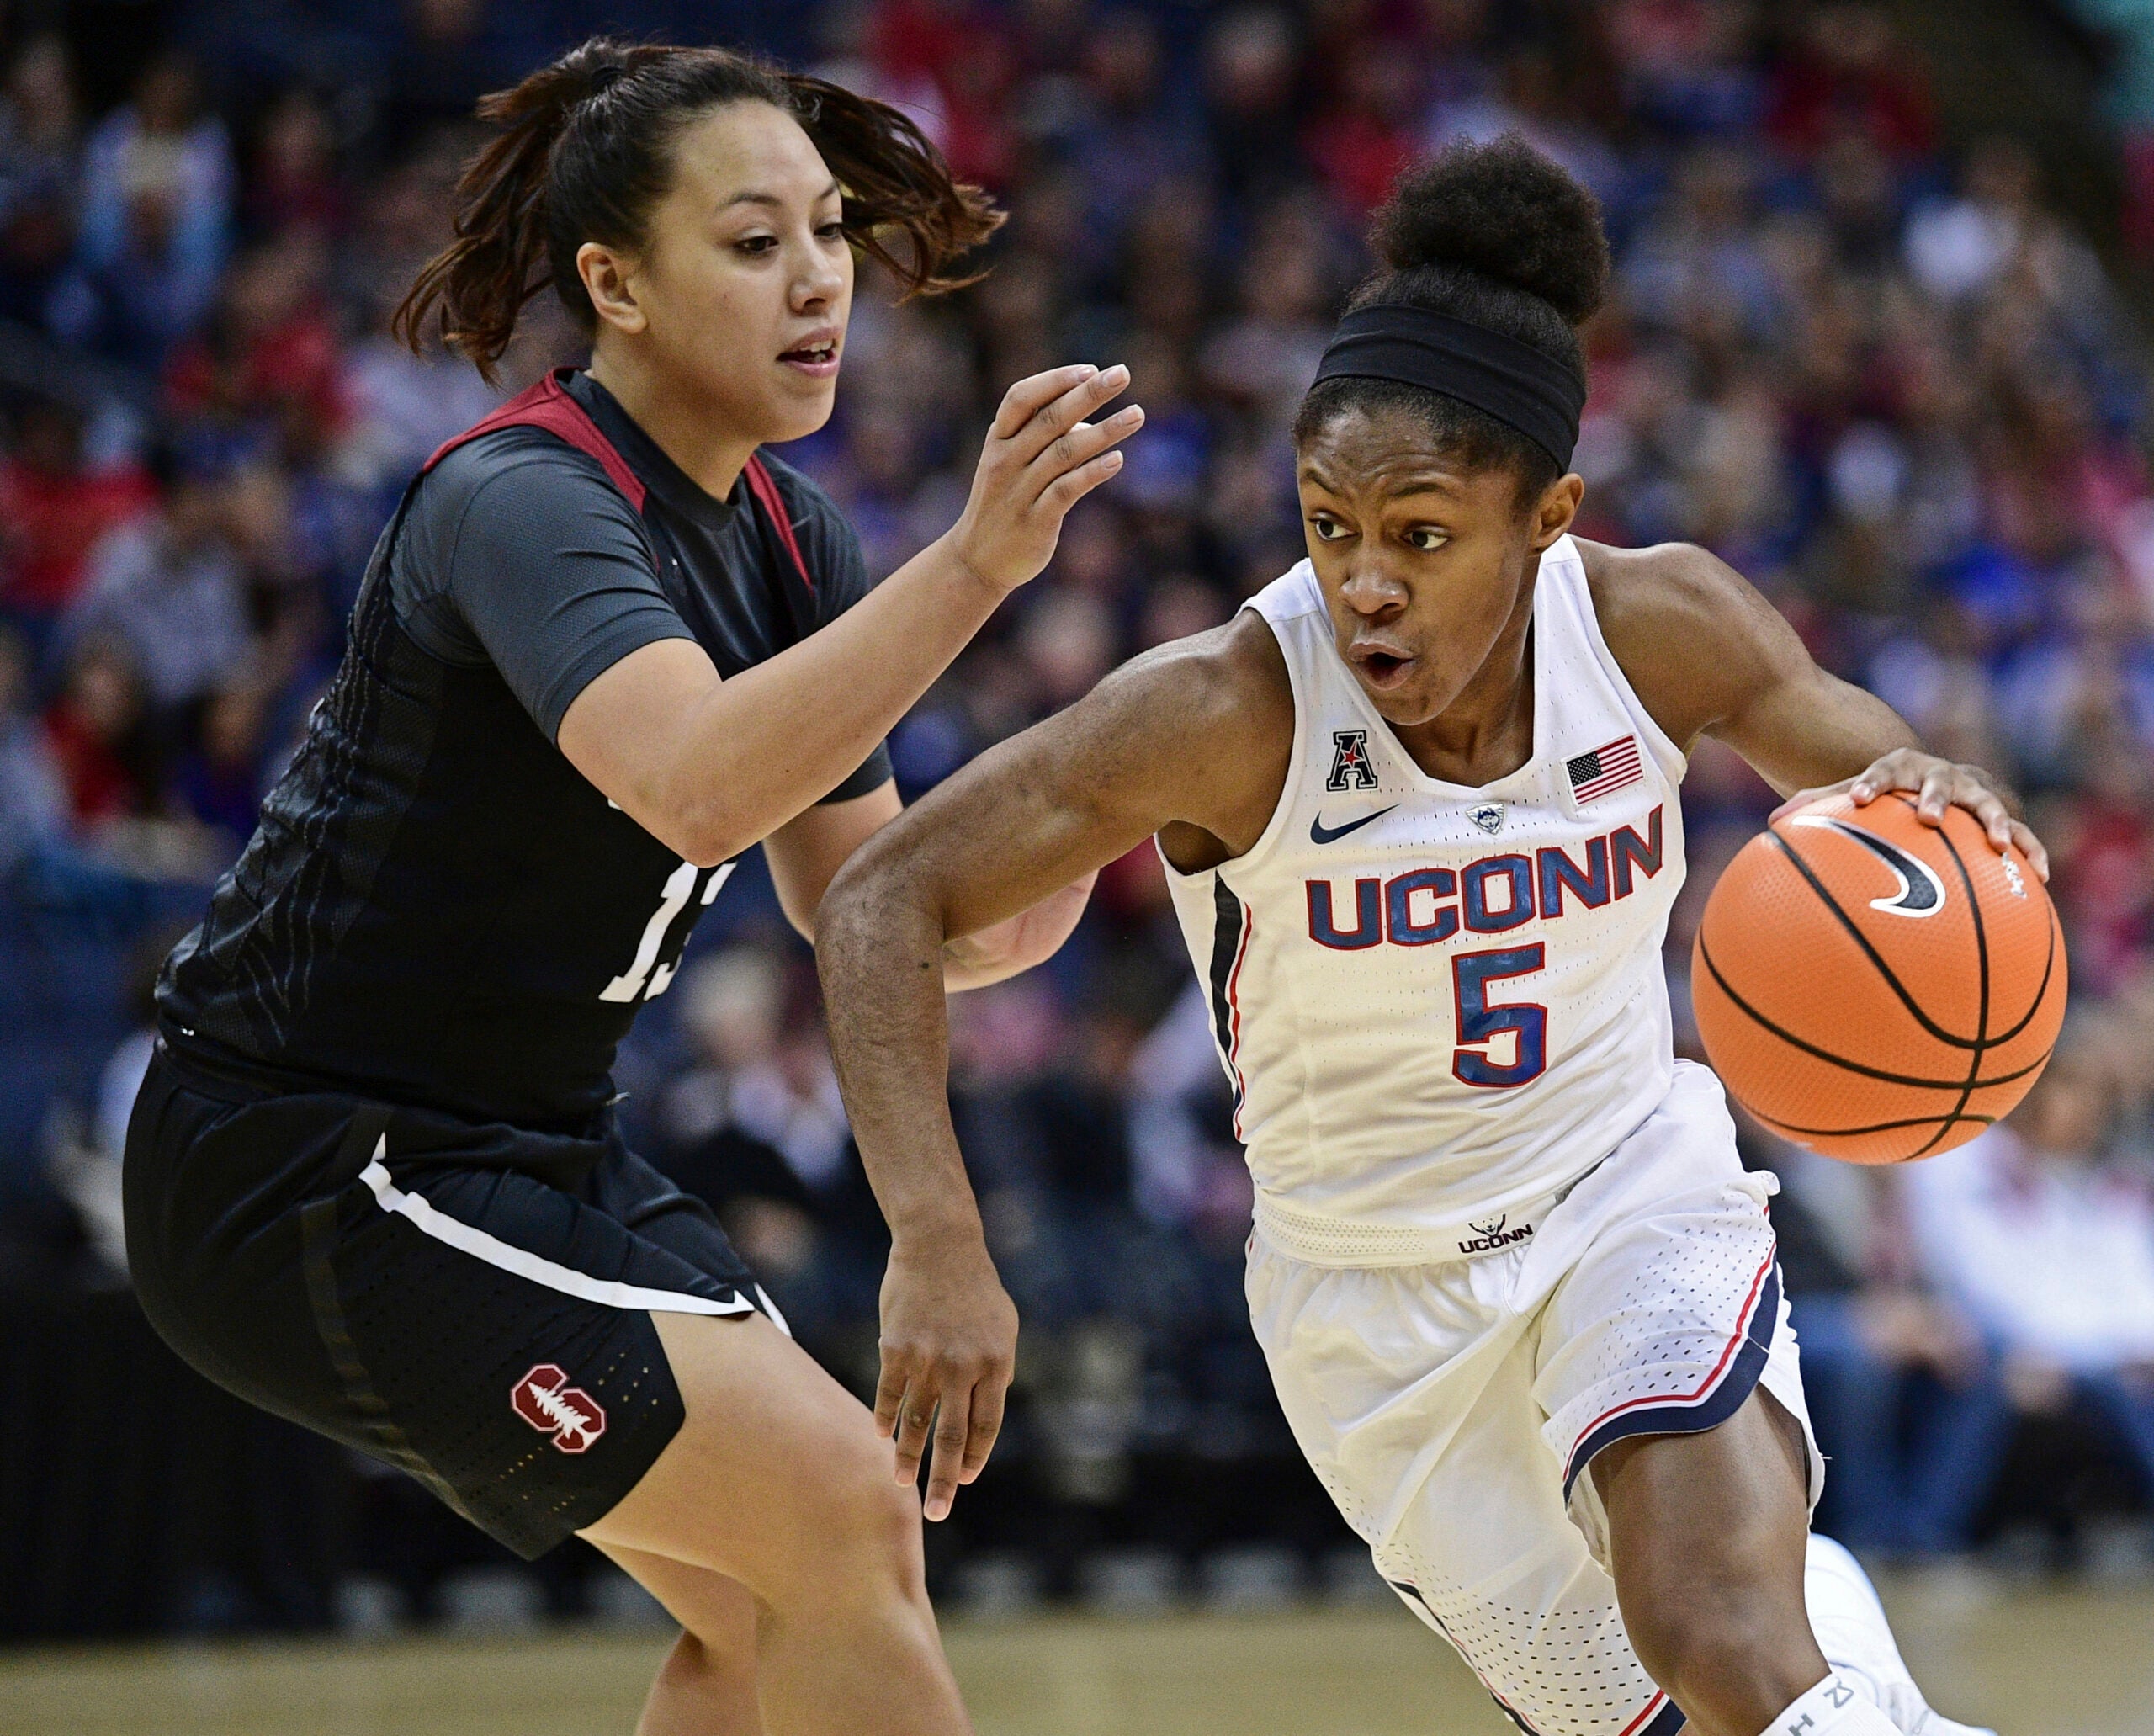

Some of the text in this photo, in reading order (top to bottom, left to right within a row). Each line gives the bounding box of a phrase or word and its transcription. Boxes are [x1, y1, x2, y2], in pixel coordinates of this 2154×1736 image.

[1326, 730, 1378, 792] A
[1305, 803, 1663, 951] UCONN
[1451, 942, 1548, 1088] 5
[1457, 1223, 1534, 1254] UCONN
